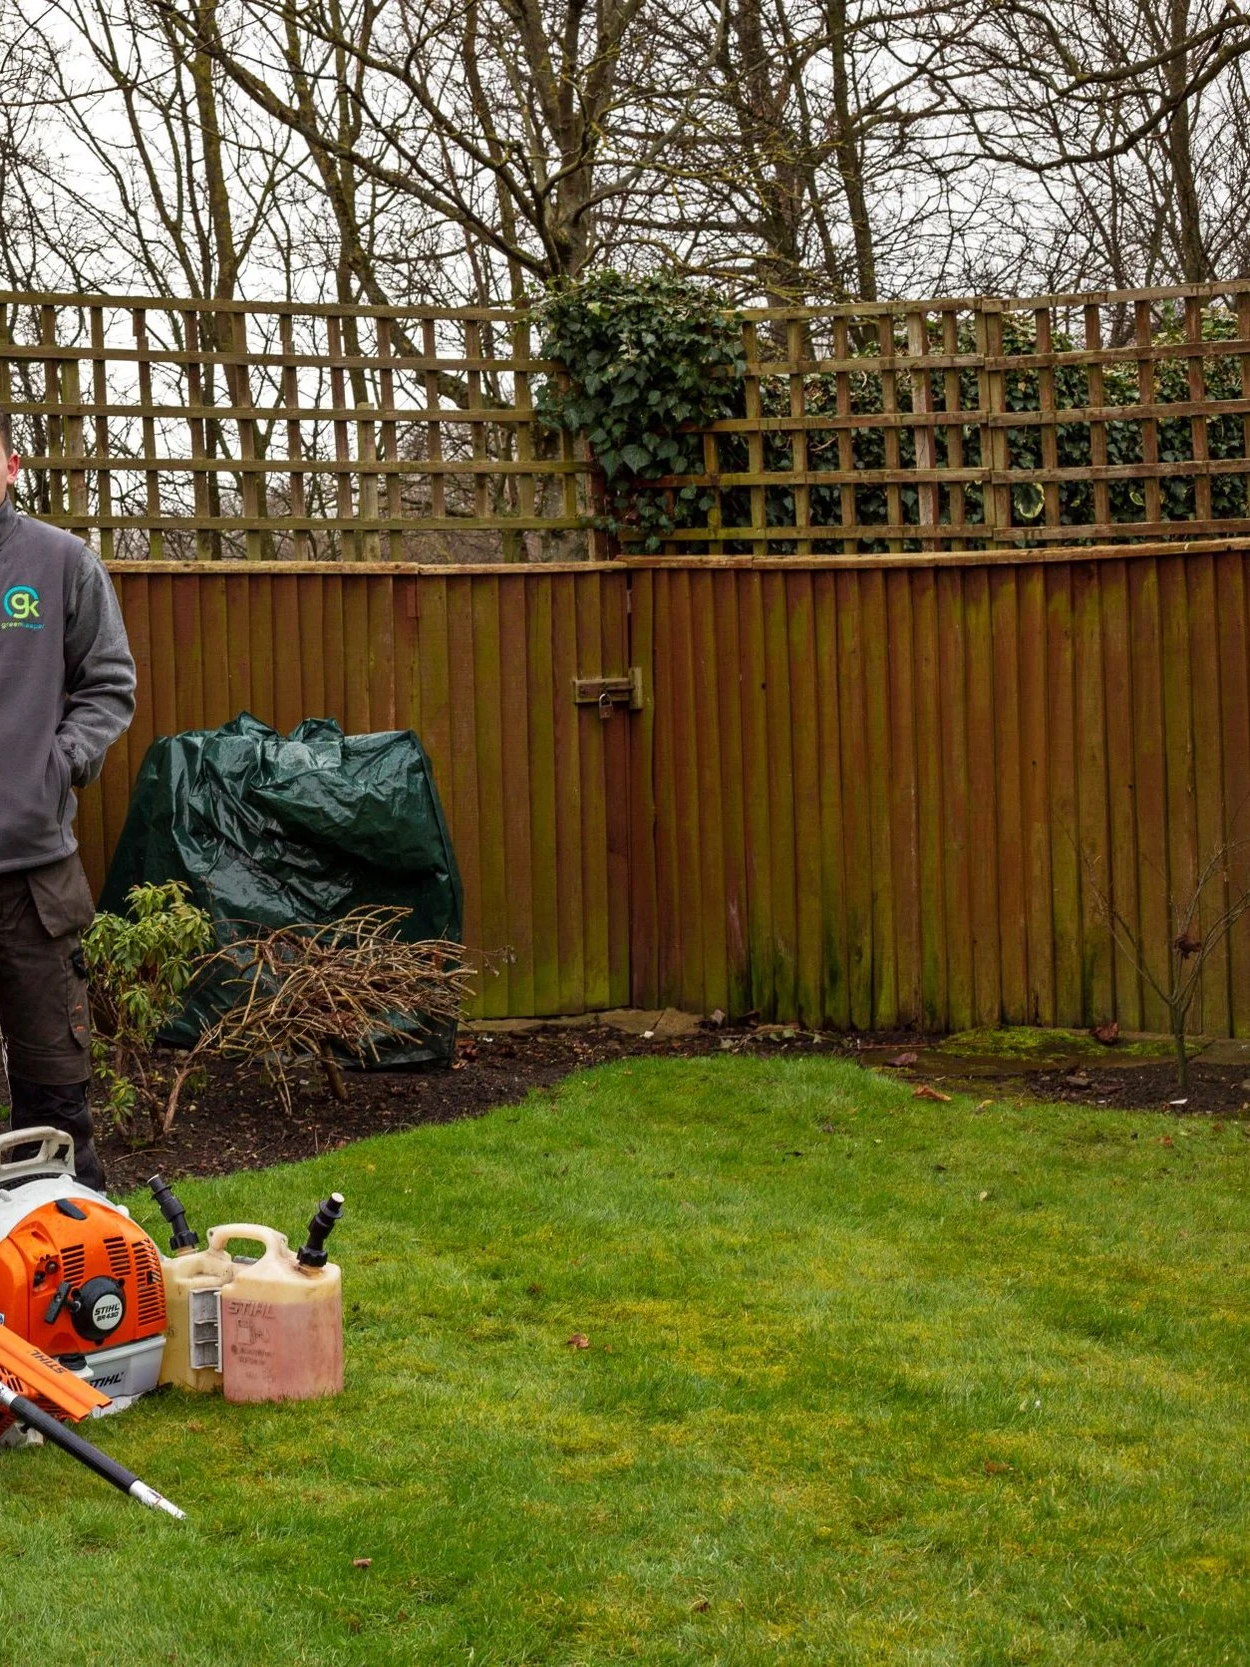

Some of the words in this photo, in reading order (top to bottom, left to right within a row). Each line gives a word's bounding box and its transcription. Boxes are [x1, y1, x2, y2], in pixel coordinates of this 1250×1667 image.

[95, 1304, 119, 1316] STIHL
[230, 1302, 276, 1319] STIHL
[31, 1350, 67, 1373] STIHL
[90, 1372, 122, 1388] TIHL
